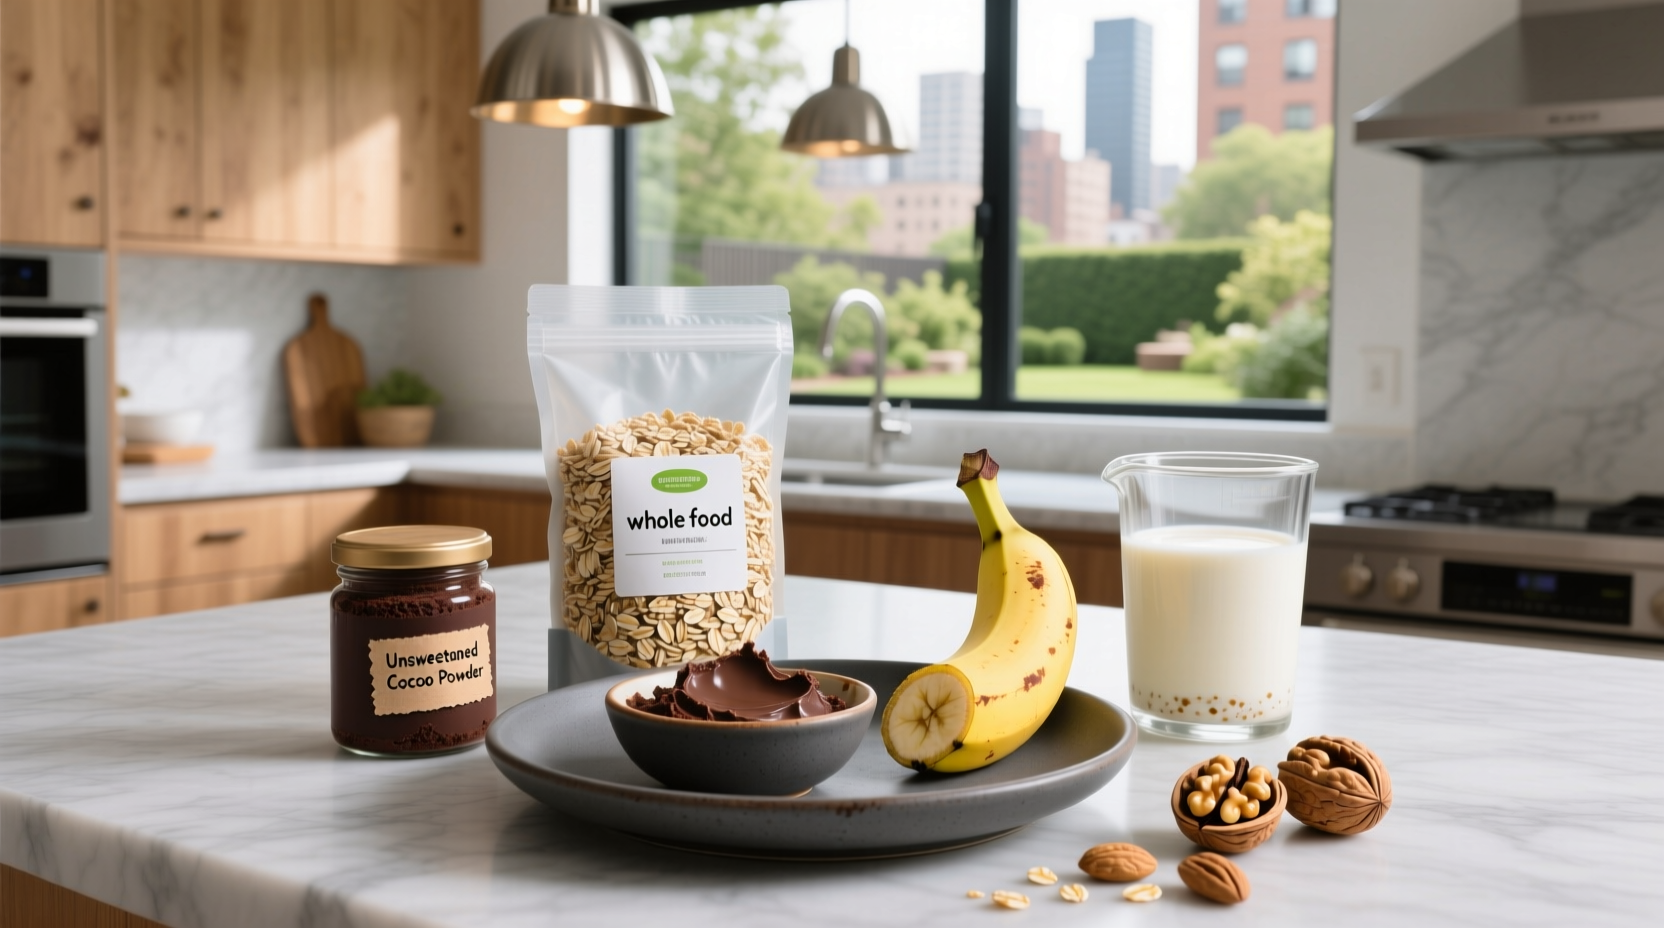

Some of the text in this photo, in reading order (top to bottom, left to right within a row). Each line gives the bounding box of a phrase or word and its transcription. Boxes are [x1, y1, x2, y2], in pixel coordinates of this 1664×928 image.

[627, 506, 732, 531] whole food
[439, 663, 484, 685] Powder
